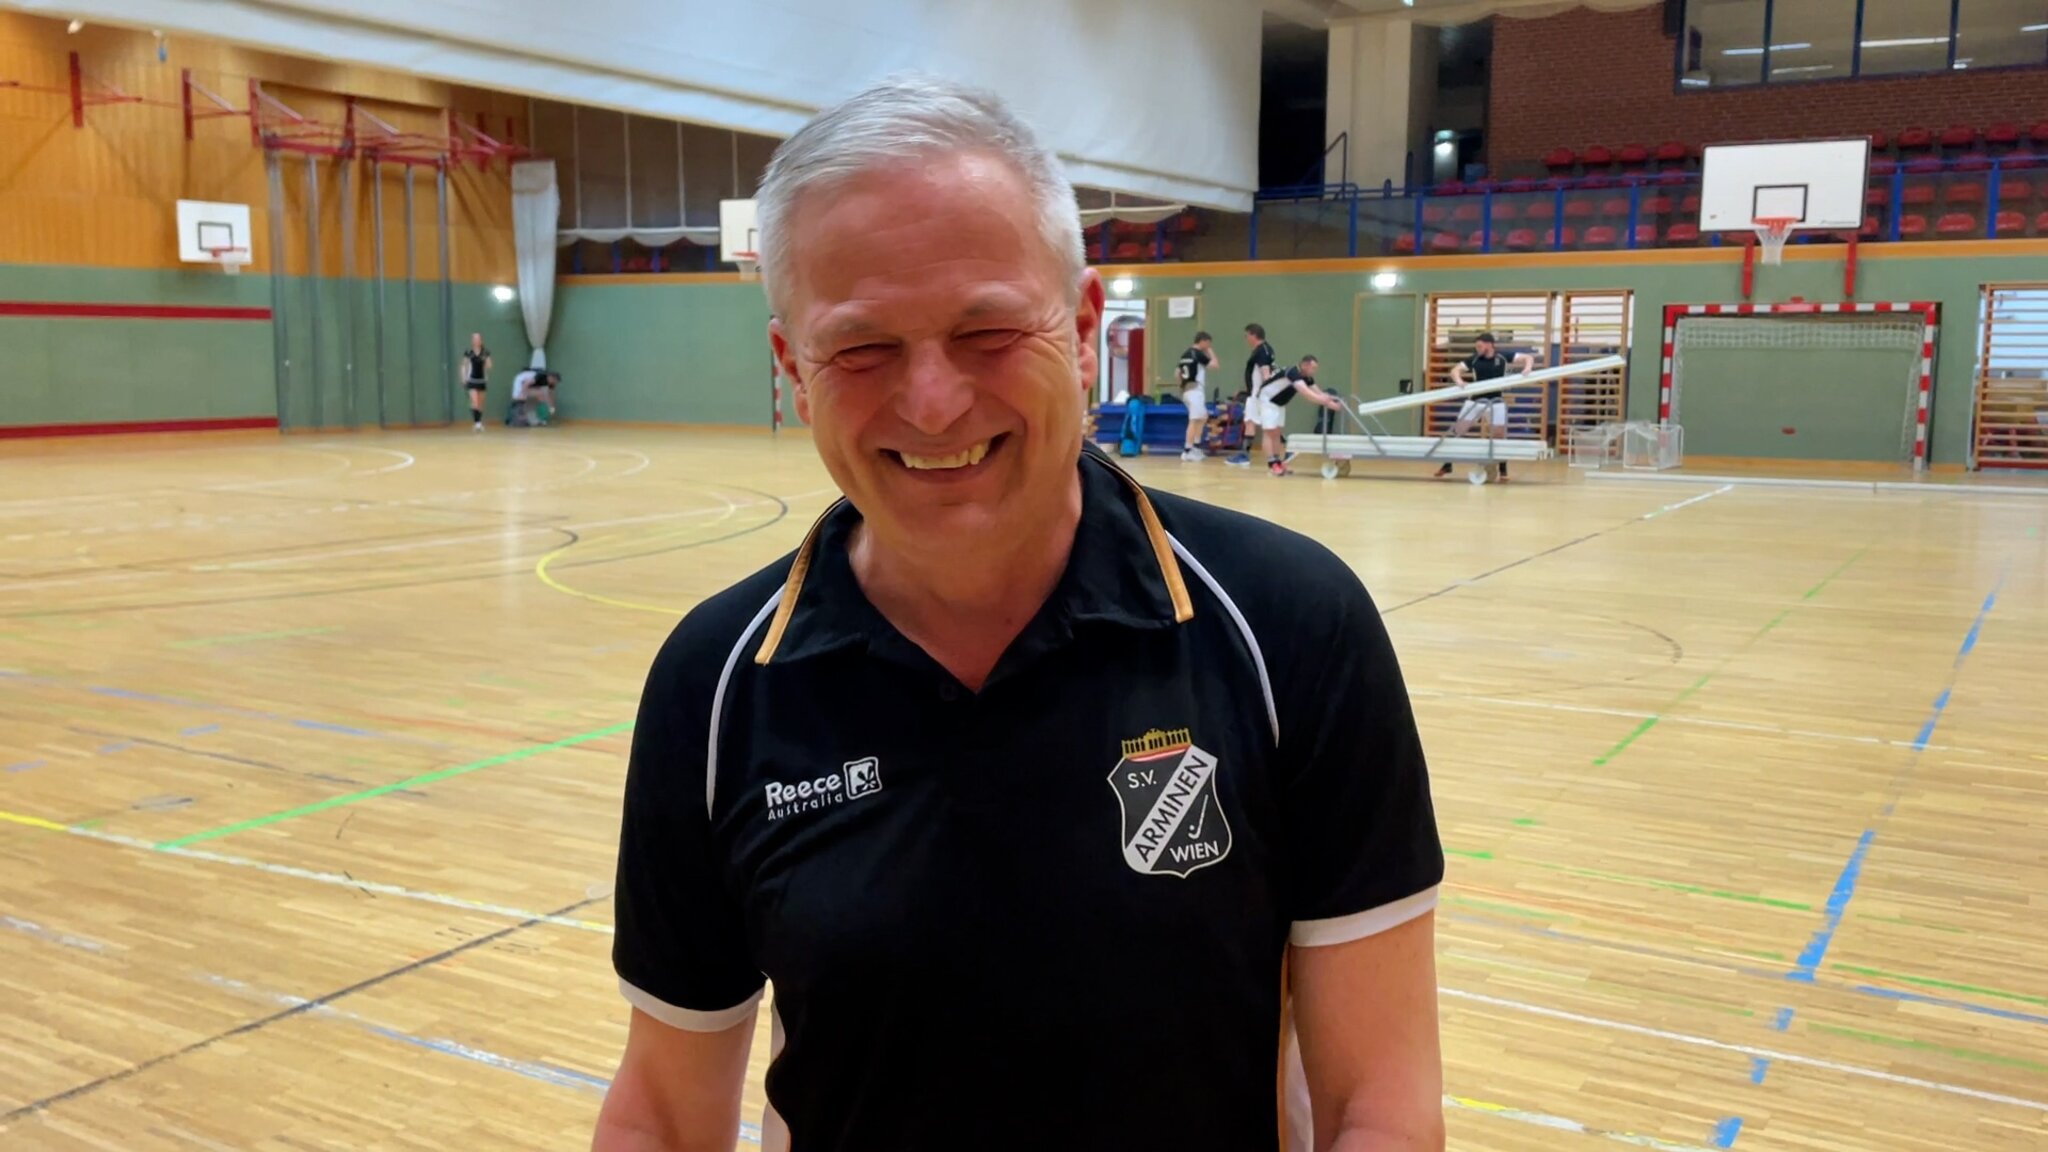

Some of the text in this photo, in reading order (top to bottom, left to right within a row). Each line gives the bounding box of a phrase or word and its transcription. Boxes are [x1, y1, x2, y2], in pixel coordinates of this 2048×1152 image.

[765, 773, 842, 808] Reece
[1127, 769, 1157, 788] S.V.
[768, 792, 843, 821] Australia
[1134, 755, 1209, 863] ARMINEN
[1170, 840, 1220, 863] WIEN
